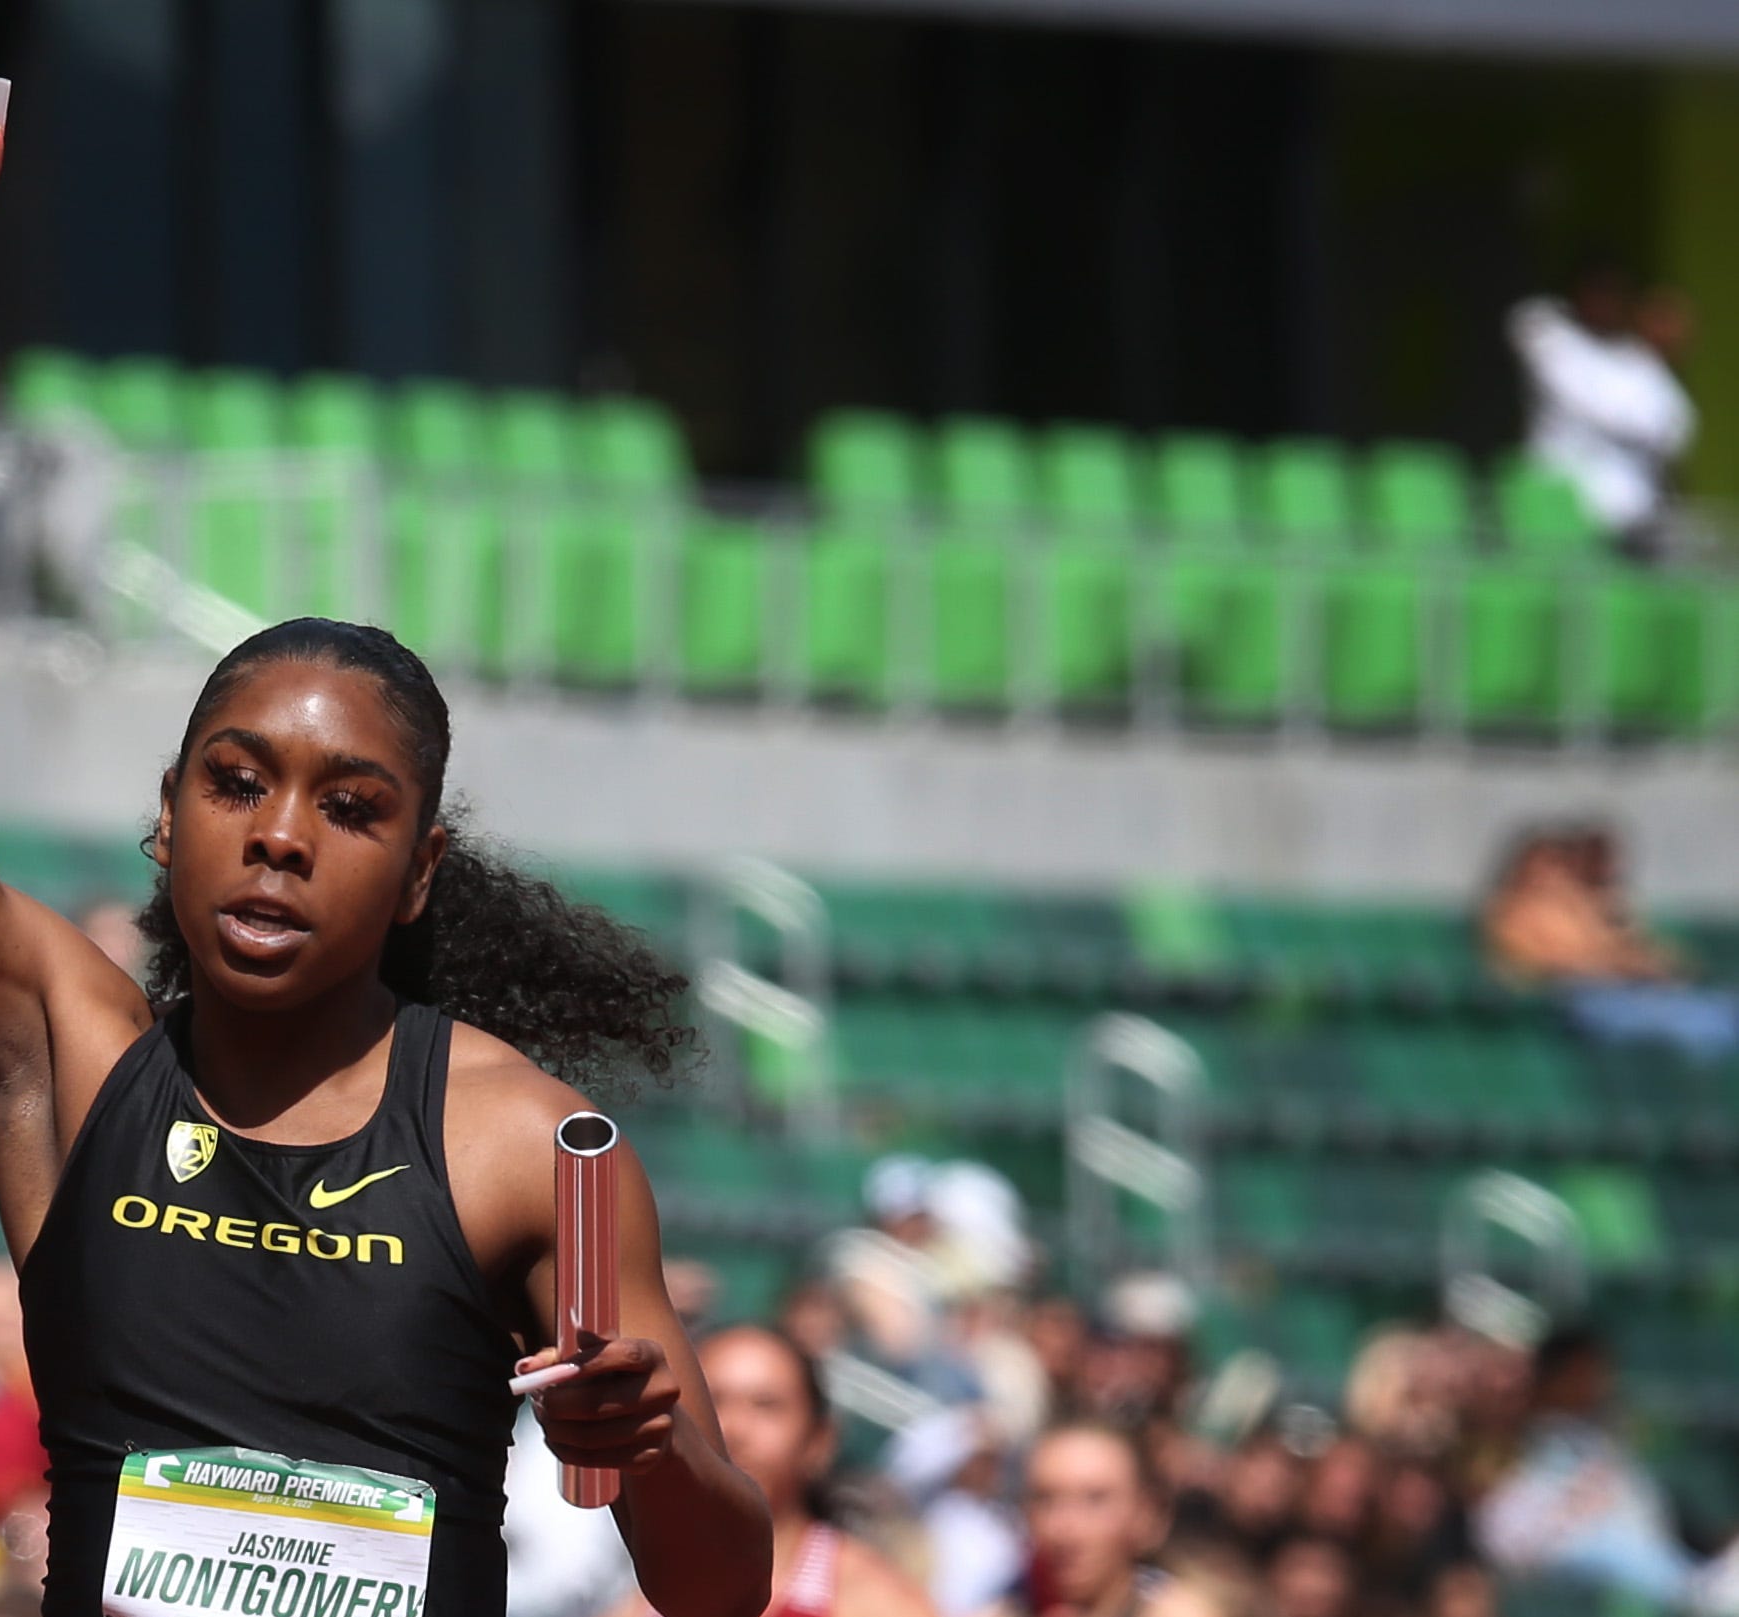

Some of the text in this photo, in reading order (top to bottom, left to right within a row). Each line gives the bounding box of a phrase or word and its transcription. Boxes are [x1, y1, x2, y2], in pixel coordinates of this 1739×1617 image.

[112, 1194, 404, 1265] OREGON
[184, 1460, 388, 1508] HAYWARD PREMIERE
[228, 1531, 336, 1567] JASMINE
